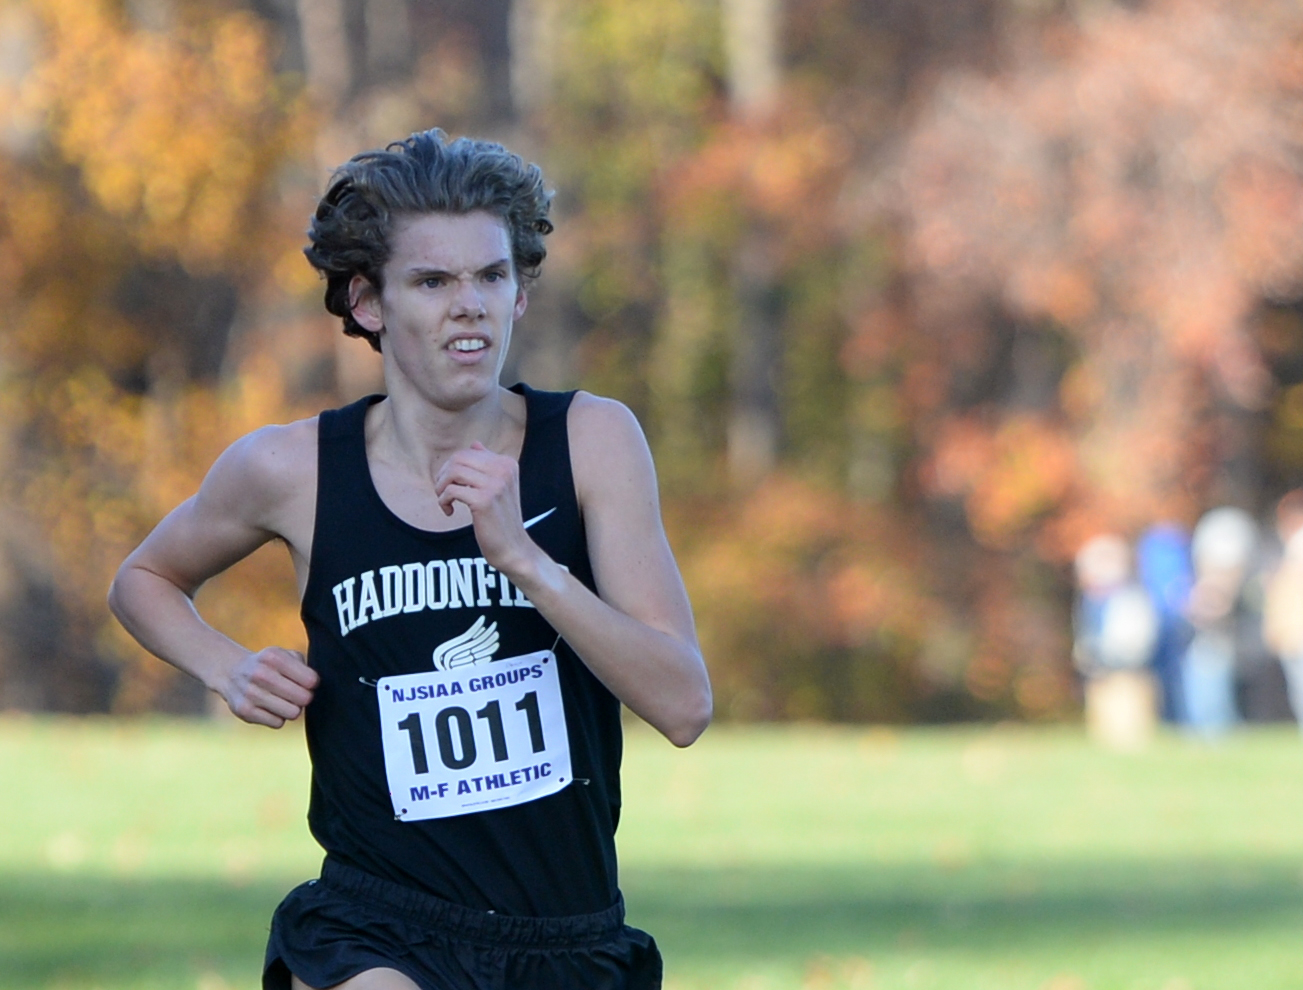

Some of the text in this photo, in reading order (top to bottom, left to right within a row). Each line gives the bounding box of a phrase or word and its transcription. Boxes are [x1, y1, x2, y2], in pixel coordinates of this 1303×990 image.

[332, 557, 570, 637] HADDONFI
[392, 664, 544, 703] NJSIAA GROUPS
[397, 690, 546, 775] 1011
[409, 782, 449, 802] M-F
[457, 762, 552, 796] ATHLETIC
